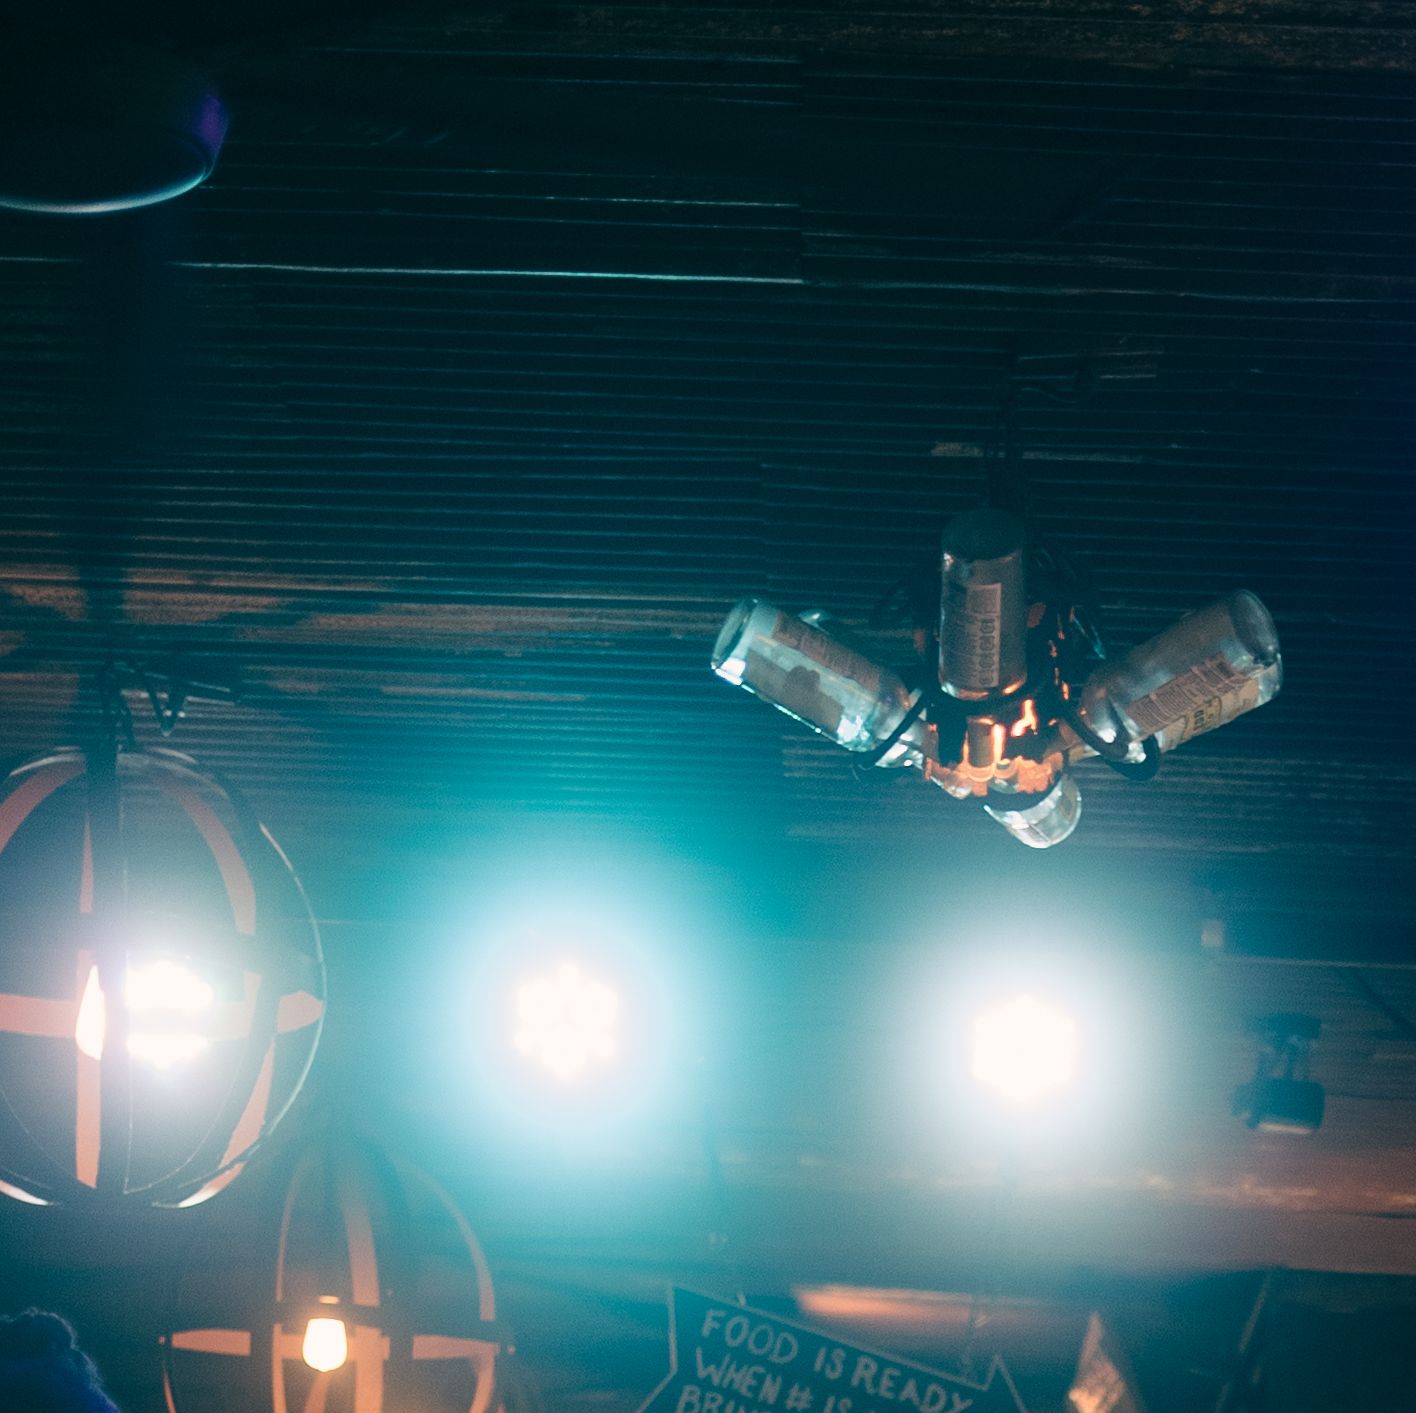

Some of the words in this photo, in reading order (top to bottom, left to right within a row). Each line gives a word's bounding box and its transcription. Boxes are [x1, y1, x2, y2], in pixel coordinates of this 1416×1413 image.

[695, 1347, 782, 1404] WHEN
[701, 1308, 799, 1364] FOOD
[813, 1346, 847, 1380] IS
